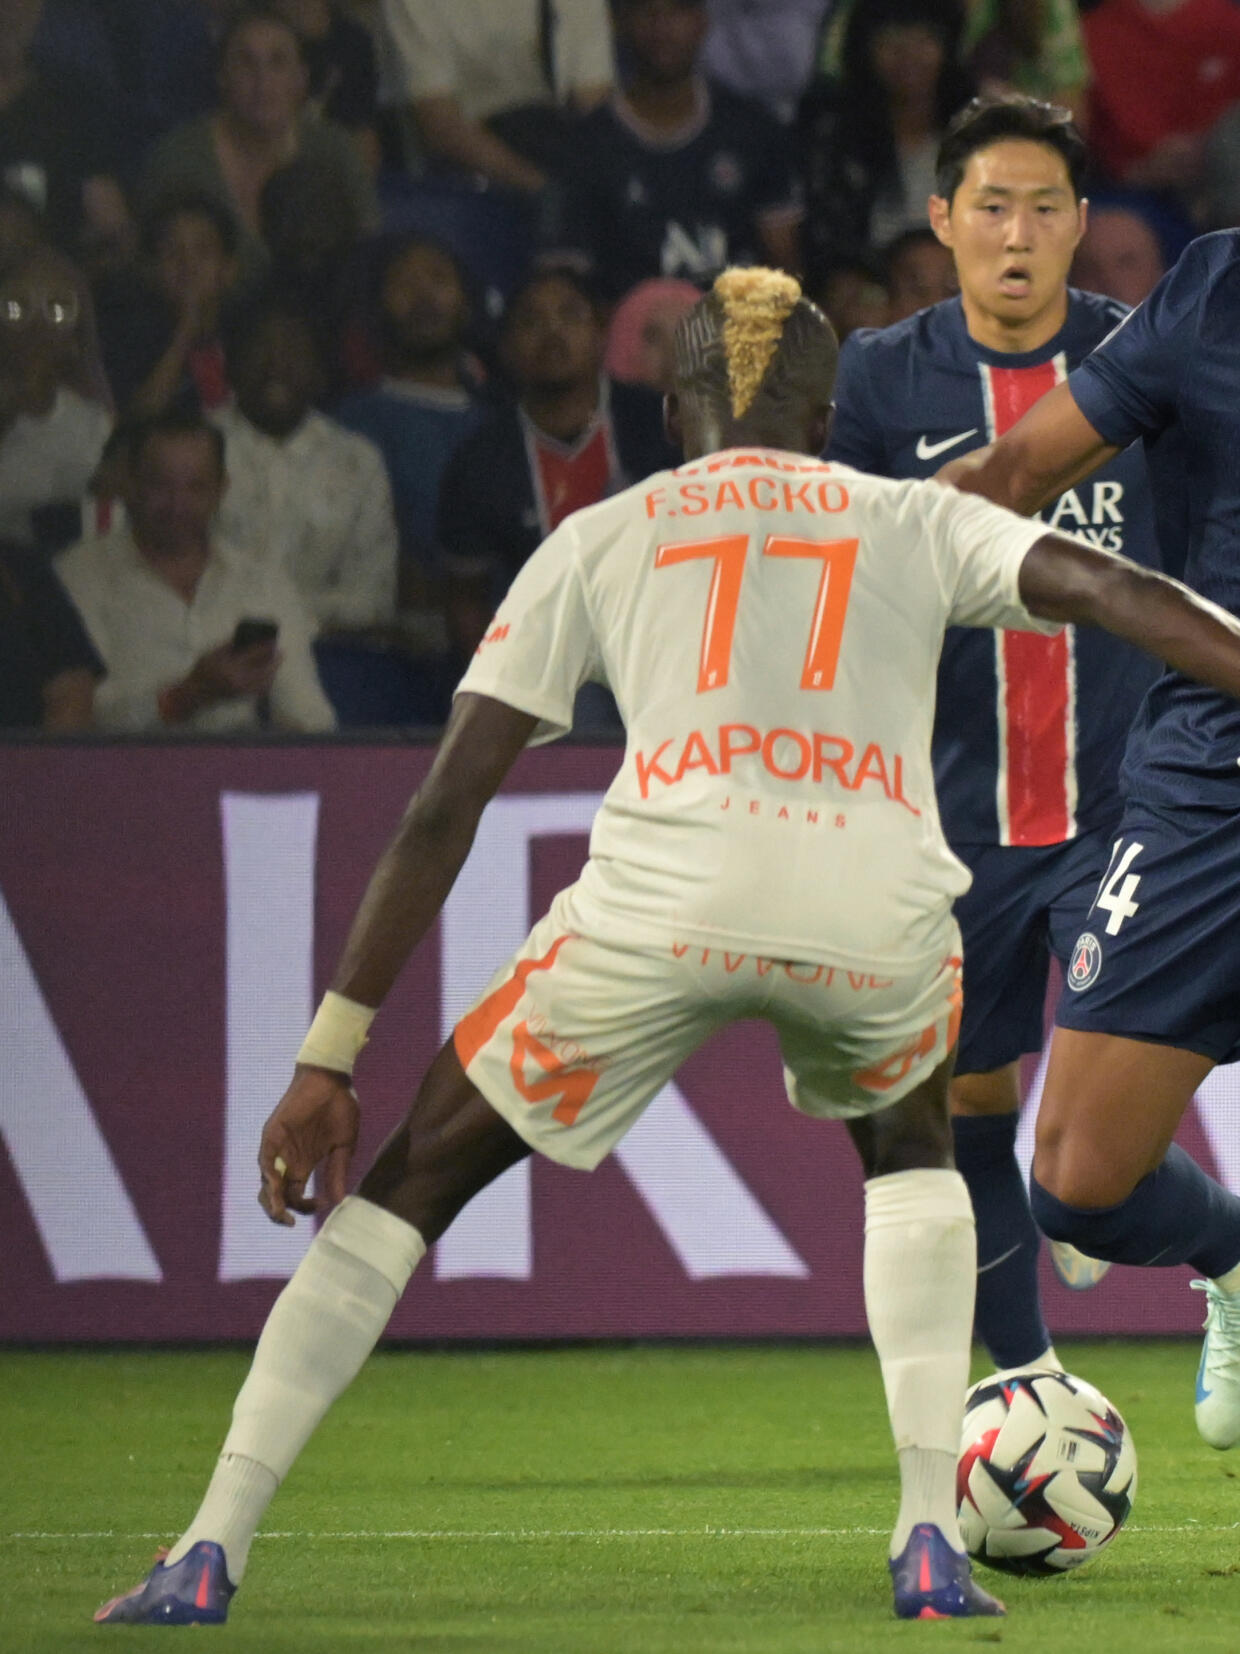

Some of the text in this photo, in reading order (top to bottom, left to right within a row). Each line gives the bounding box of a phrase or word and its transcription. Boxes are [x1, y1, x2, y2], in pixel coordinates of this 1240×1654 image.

[645, 477, 850, 518] F.SACKO
[1044, 481, 1124, 526] AR
[654, 533, 860, 694] 77
[635, 723, 921, 817] KAPORAL
[721, 797, 846, 828] JEANS
[1087, 838, 1144, 936] 4
